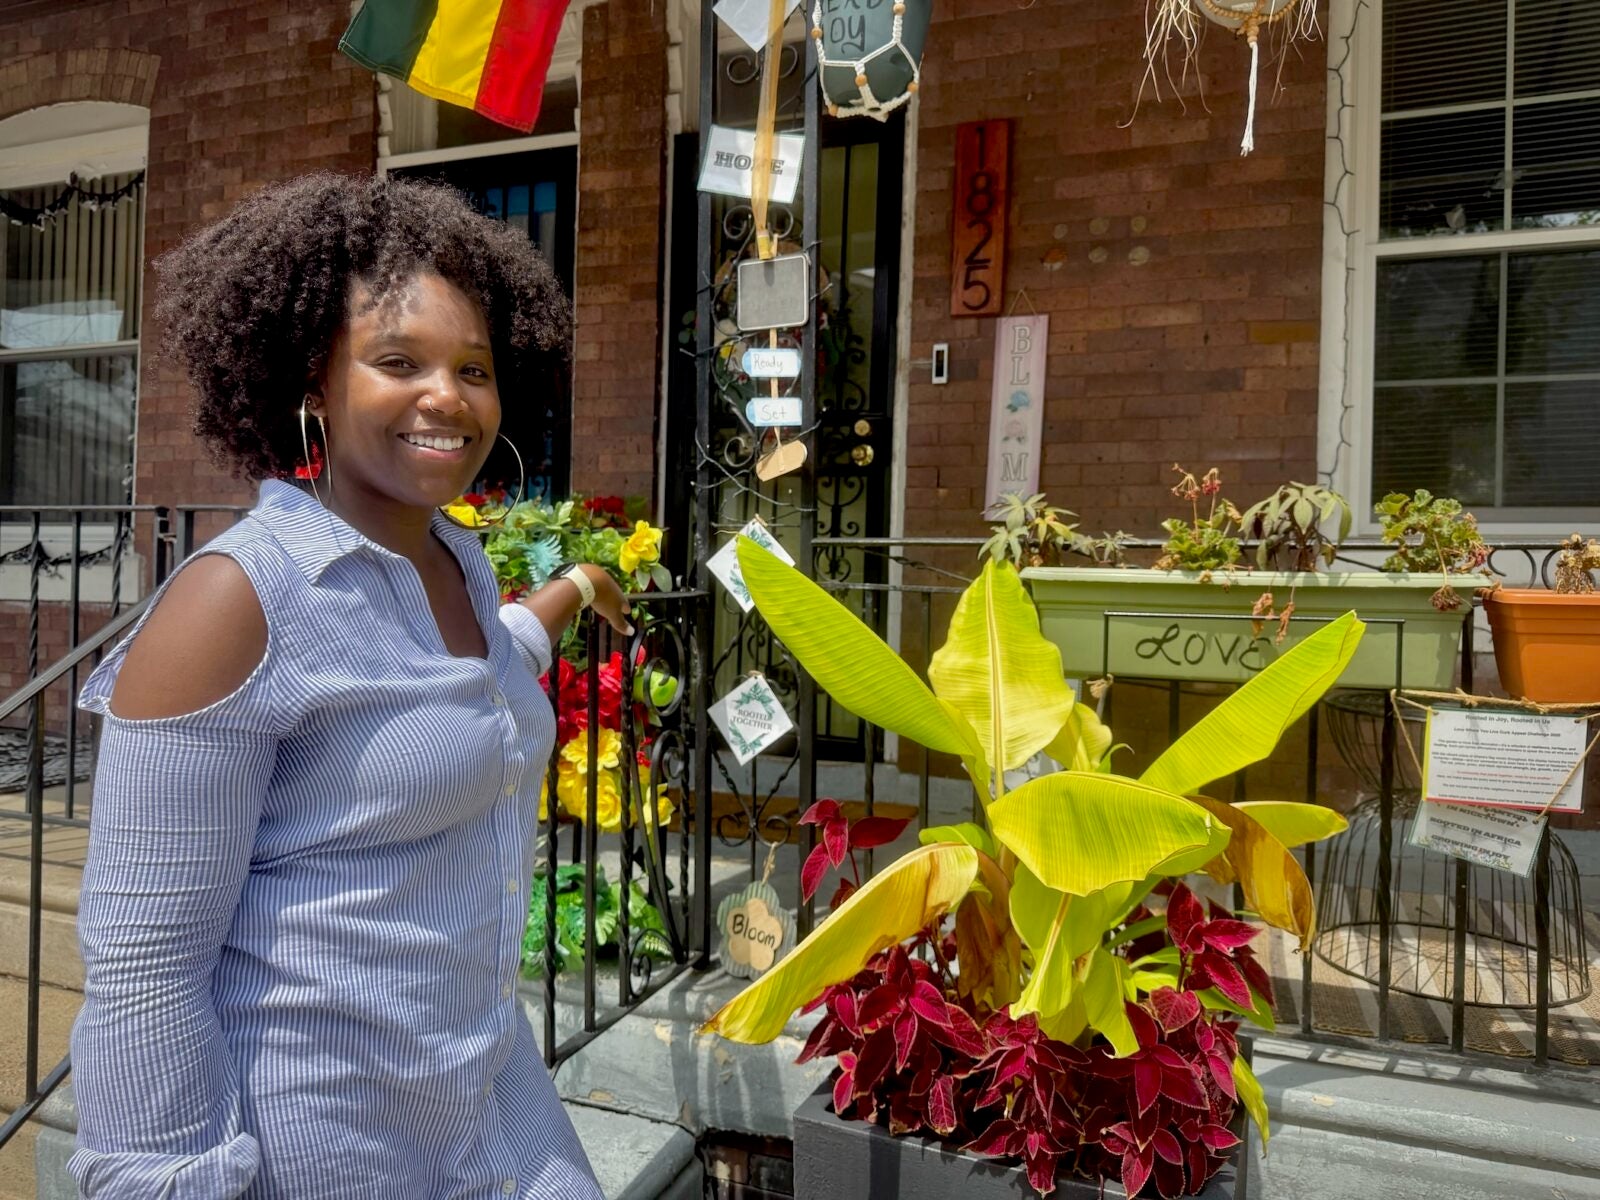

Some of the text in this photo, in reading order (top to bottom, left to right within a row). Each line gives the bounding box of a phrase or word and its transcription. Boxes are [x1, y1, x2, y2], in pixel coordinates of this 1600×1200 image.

[713, 150, 785, 175] HOE
[962, 127, 993, 311] 1825
[753, 353, 784, 373] Ready
[761, 404, 788, 422] Set
[1135, 623, 1271, 671] LOVE
[731, 715, 773, 731] TOGETHER
[1430, 817, 1470, 832] ROOTED
[1483, 831, 1522, 846] AFRICA
[732, 914, 776, 949] Bloom
